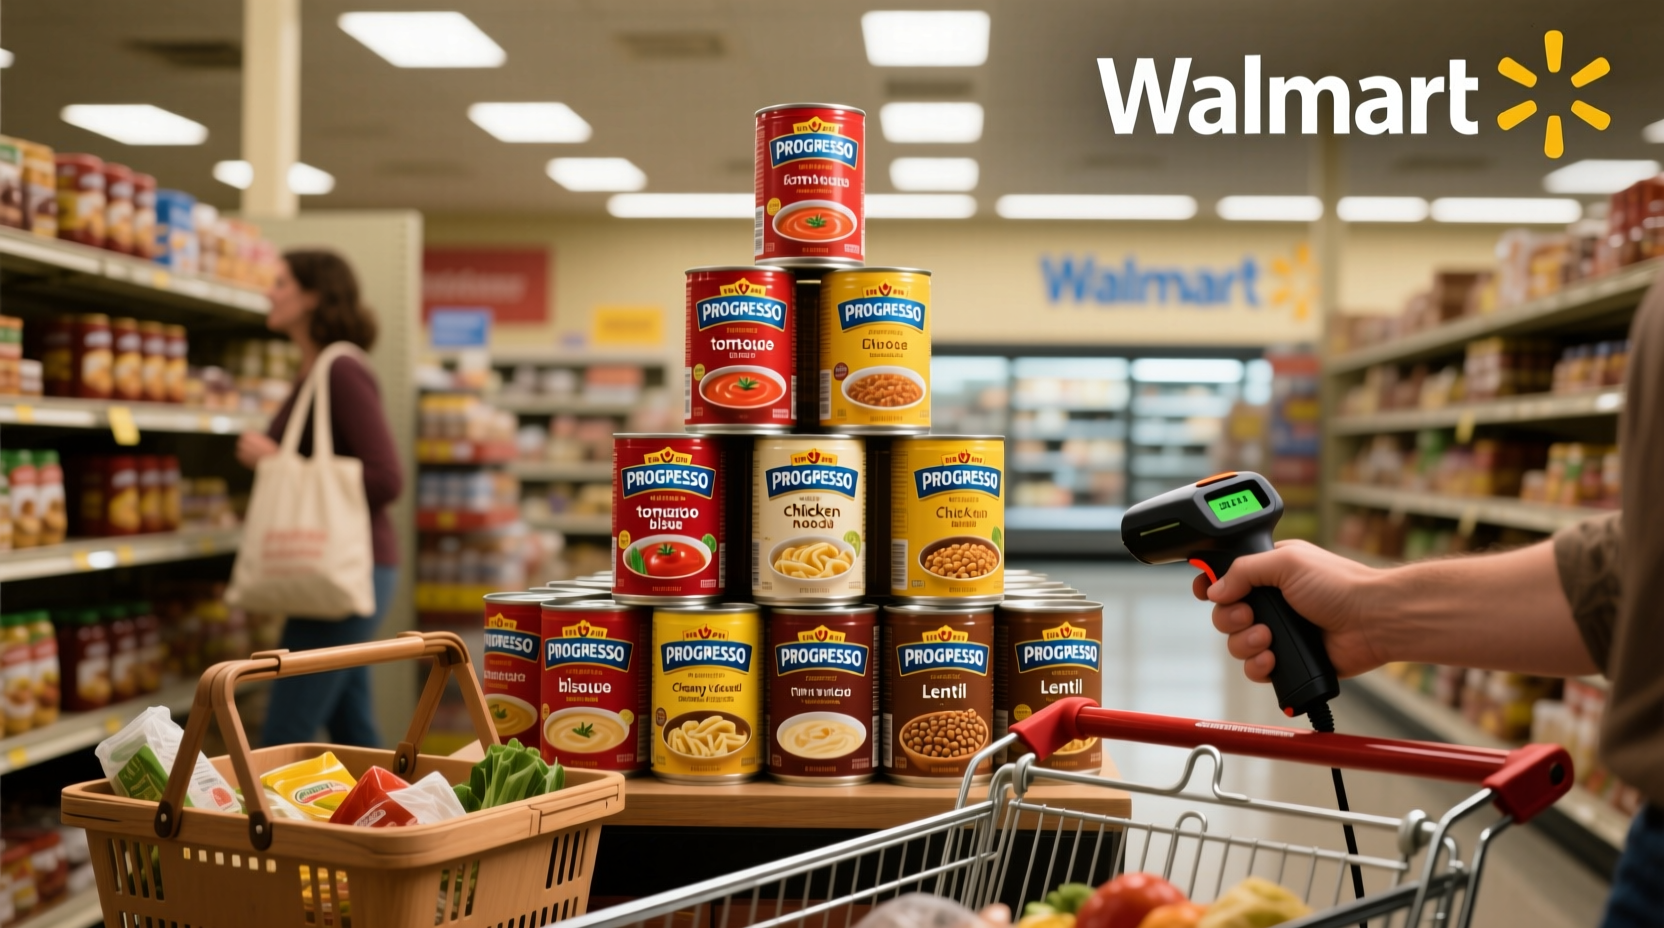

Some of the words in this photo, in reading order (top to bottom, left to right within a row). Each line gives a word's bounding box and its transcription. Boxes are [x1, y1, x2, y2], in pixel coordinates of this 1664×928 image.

[776, 138, 854, 160] PROGRESSO
[1040, 255, 1261, 307] Walmart
[702, 301, 782, 321] PROGRESSO
[845, 302, 922, 322] PROGRESSO
[626, 469, 709, 490] PROGRESSO
[772, 470, 853, 490] PROGRESSO
[922, 469, 998, 490] PROGRESSO
[548, 643, 625, 662] PROGRESSO
[666, 645, 746, 664] PROGRESSO
[781, 648, 862, 667] PROGRESSO
[904, 648, 984, 667] PROGRESSO
[1024, 645, 1098, 664] PROGRESSO
[922, 683, 967, 699] Lentil
[1041, 679, 1083, 695] Lentil
